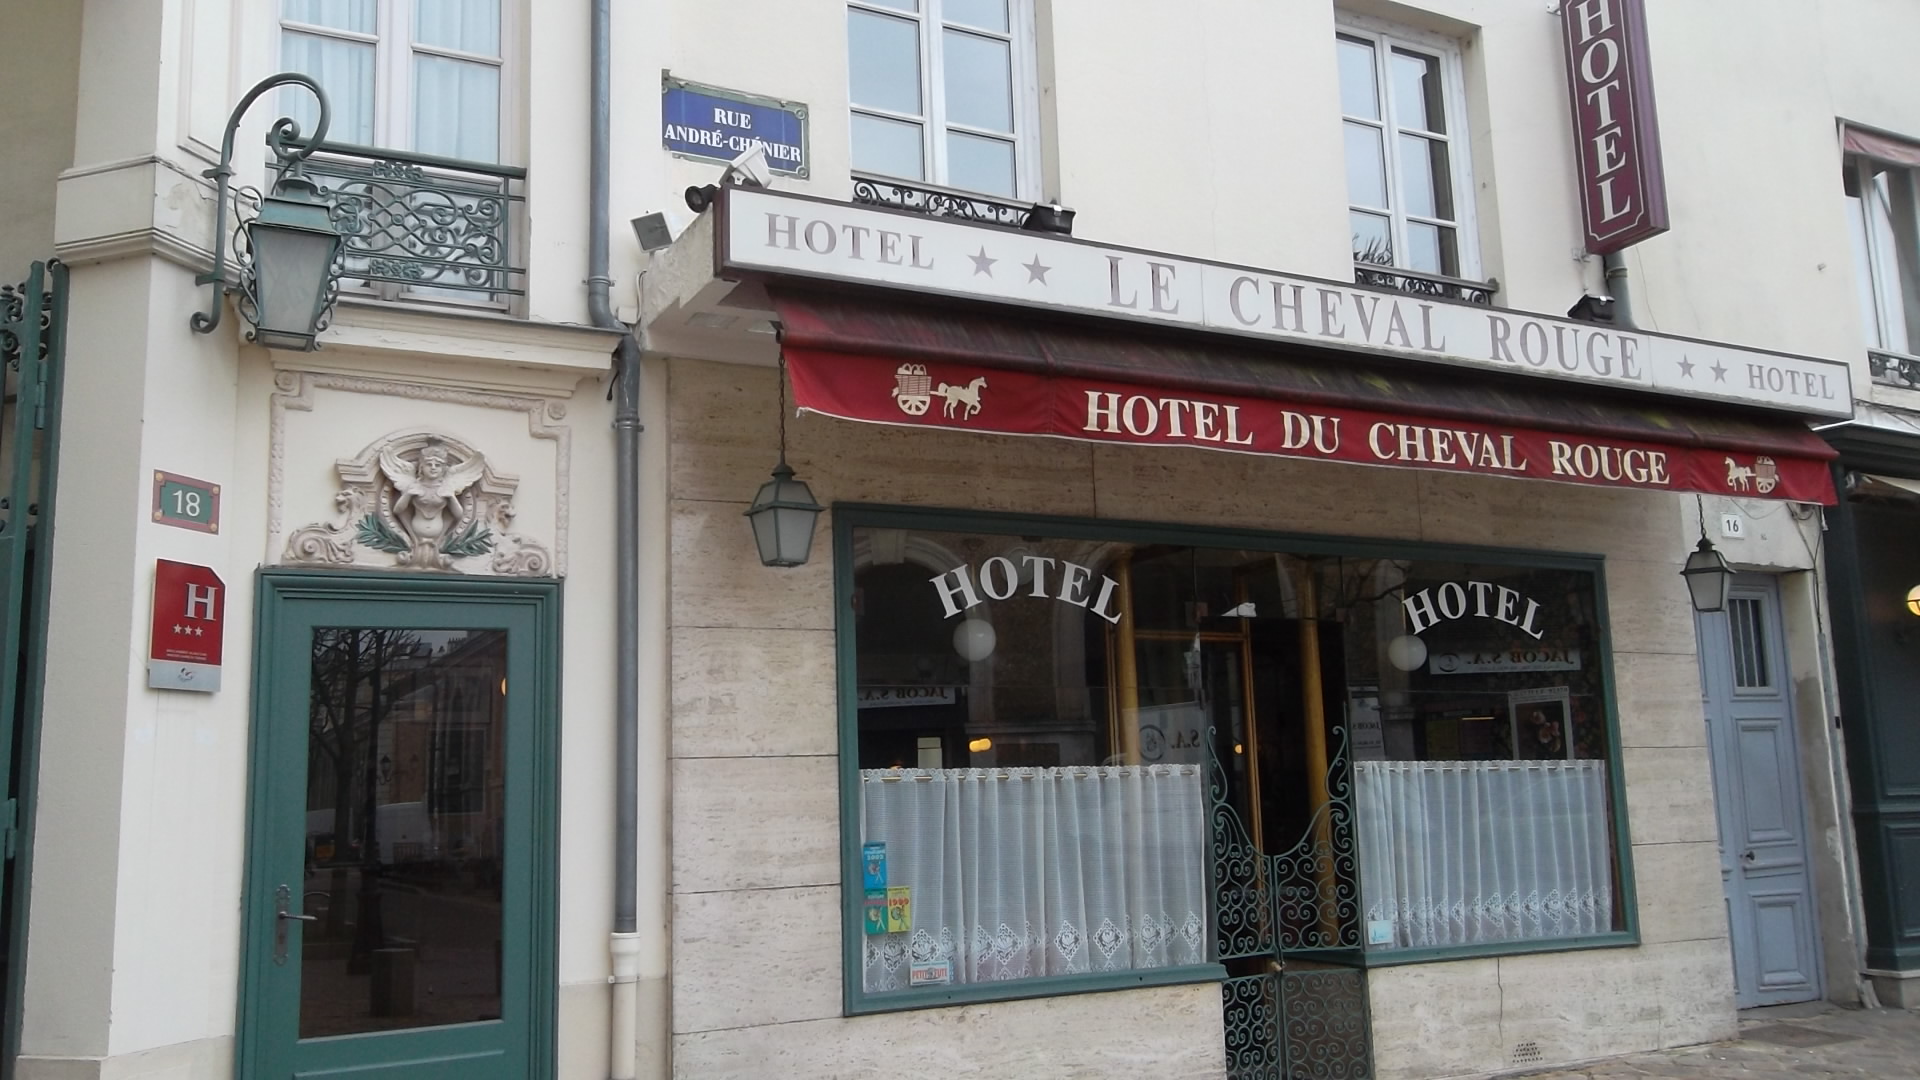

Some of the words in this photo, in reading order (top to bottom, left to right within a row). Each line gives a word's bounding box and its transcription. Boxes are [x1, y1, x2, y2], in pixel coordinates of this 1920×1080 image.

[713, 107, 752, 130] RUE
[1575, 0, 1631, 223] HOTEL
[763, 212, 934, 271] HOTEL
[1104, 254, 1180, 315] LE
[1229, 275, 1447, 353] CHEVAL
[1486, 314, 1642, 381] ROUGE
[1747, 362, 1835, 401] HOTEL
[1083, 390, 1254, 447] HOTEL
[1281, 409, 1340, 455] DU
[1368, 422, 1527, 472] CHEVAL
[1551, 441, 1671, 485] ROUGE
[172, 489, 201, 517] 18
[1726, 519, 1739, 532] 16
[184, 582, 219, 621] H
[929, 555, 1122, 625] HOTEL
[1402, 580, 1544, 640] HOTEL
